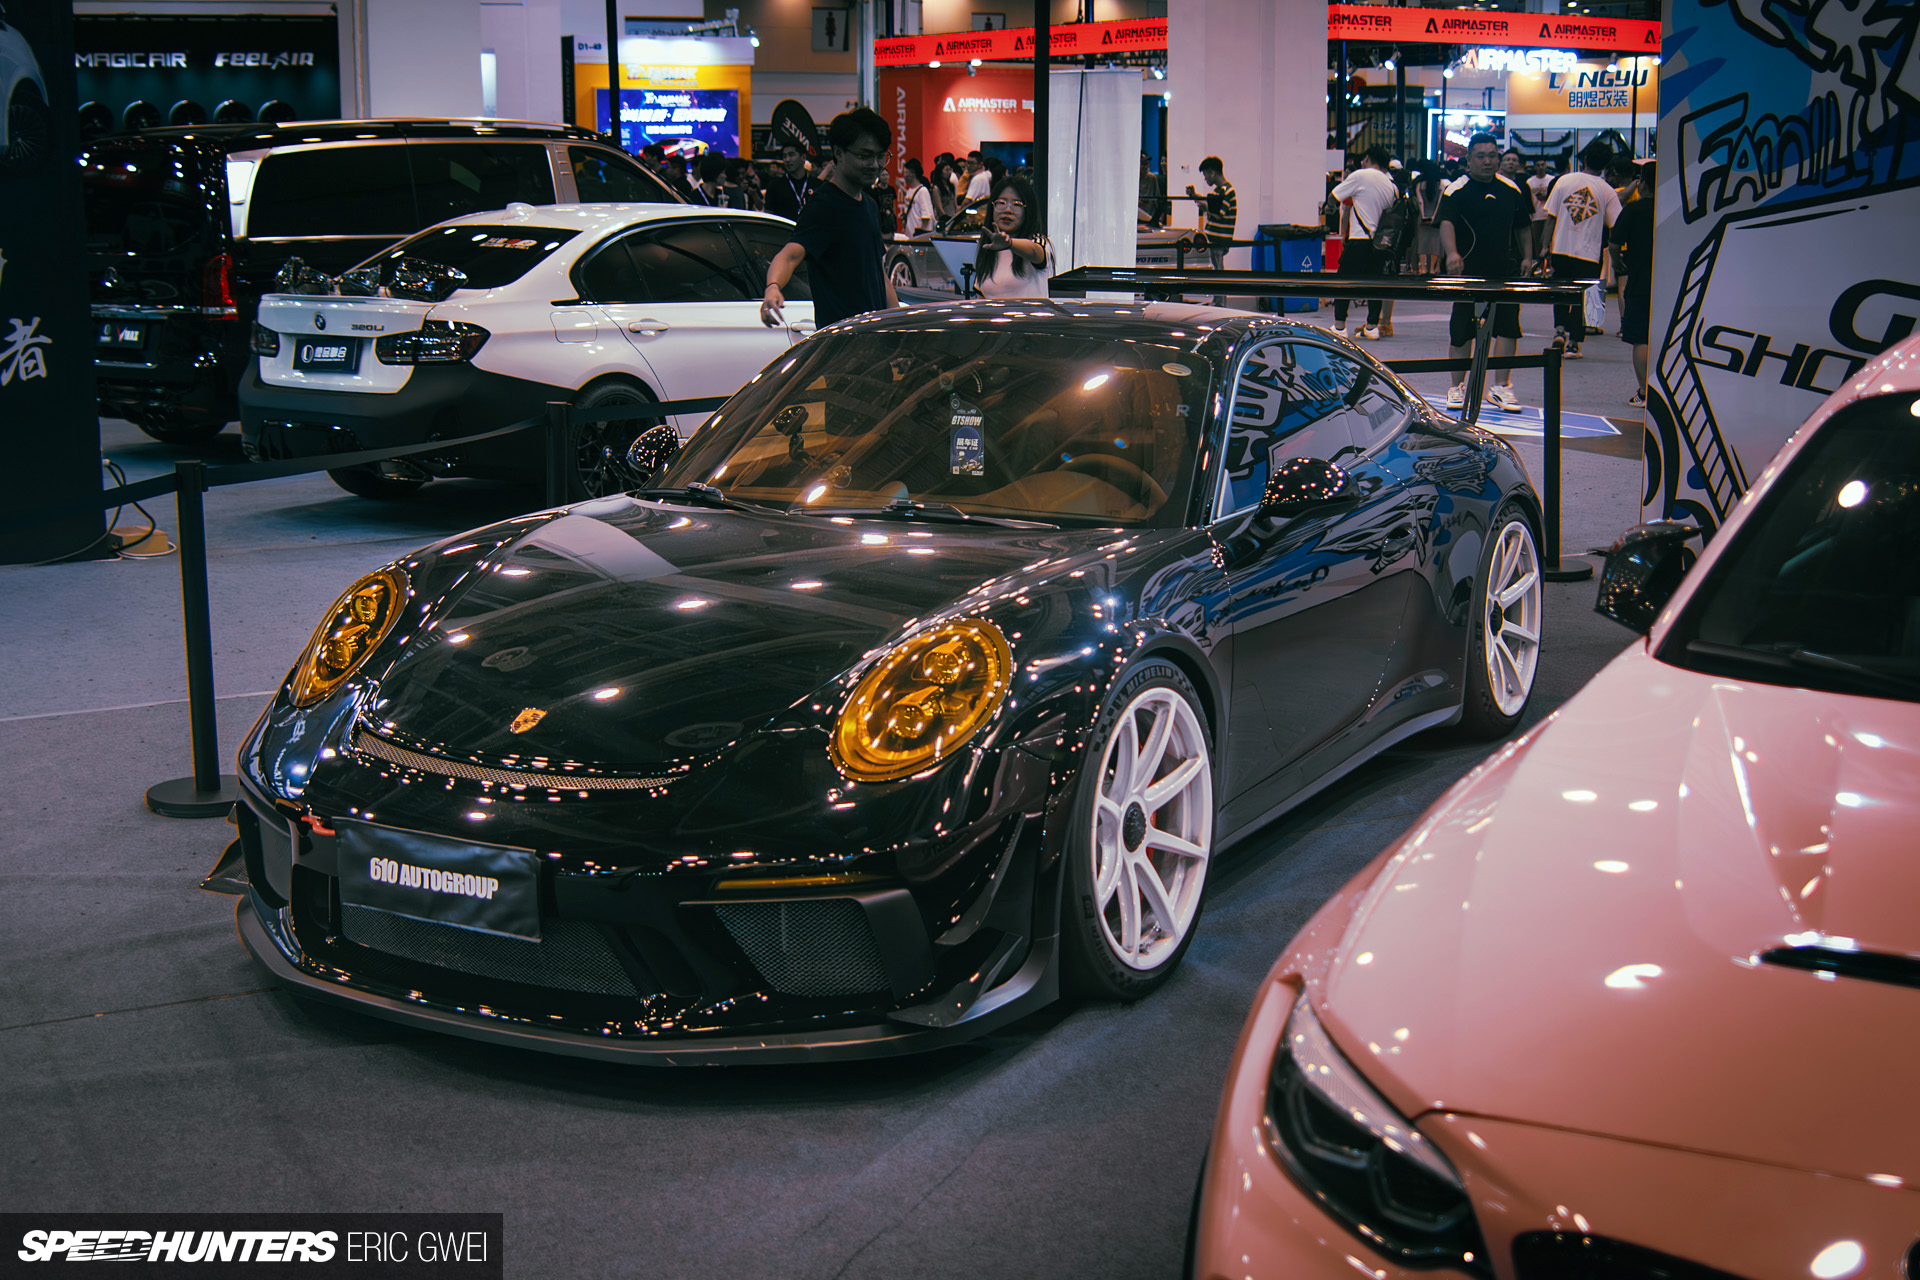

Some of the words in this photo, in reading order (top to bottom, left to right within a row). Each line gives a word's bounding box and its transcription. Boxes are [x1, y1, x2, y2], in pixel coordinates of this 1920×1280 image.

[1443, 19, 1509, 31] AIRMASTER
[1555, 24, 1616, 37] AIRMASTER
[946, 39, 992, 51] AIRMASTER
[1465, 49, 1576, 73] AIRMASTER
[958, 98, 1017, 109] AIRMASTER
[1568, 90, 1628, 107] 朗煜改装
[0, 317, 52, 386] 者
[1126, 665, 1173, 697] MICHELIN
[370, 857, 398, 884] 610
[399, 863, 499, 899] AUTOGROUP
